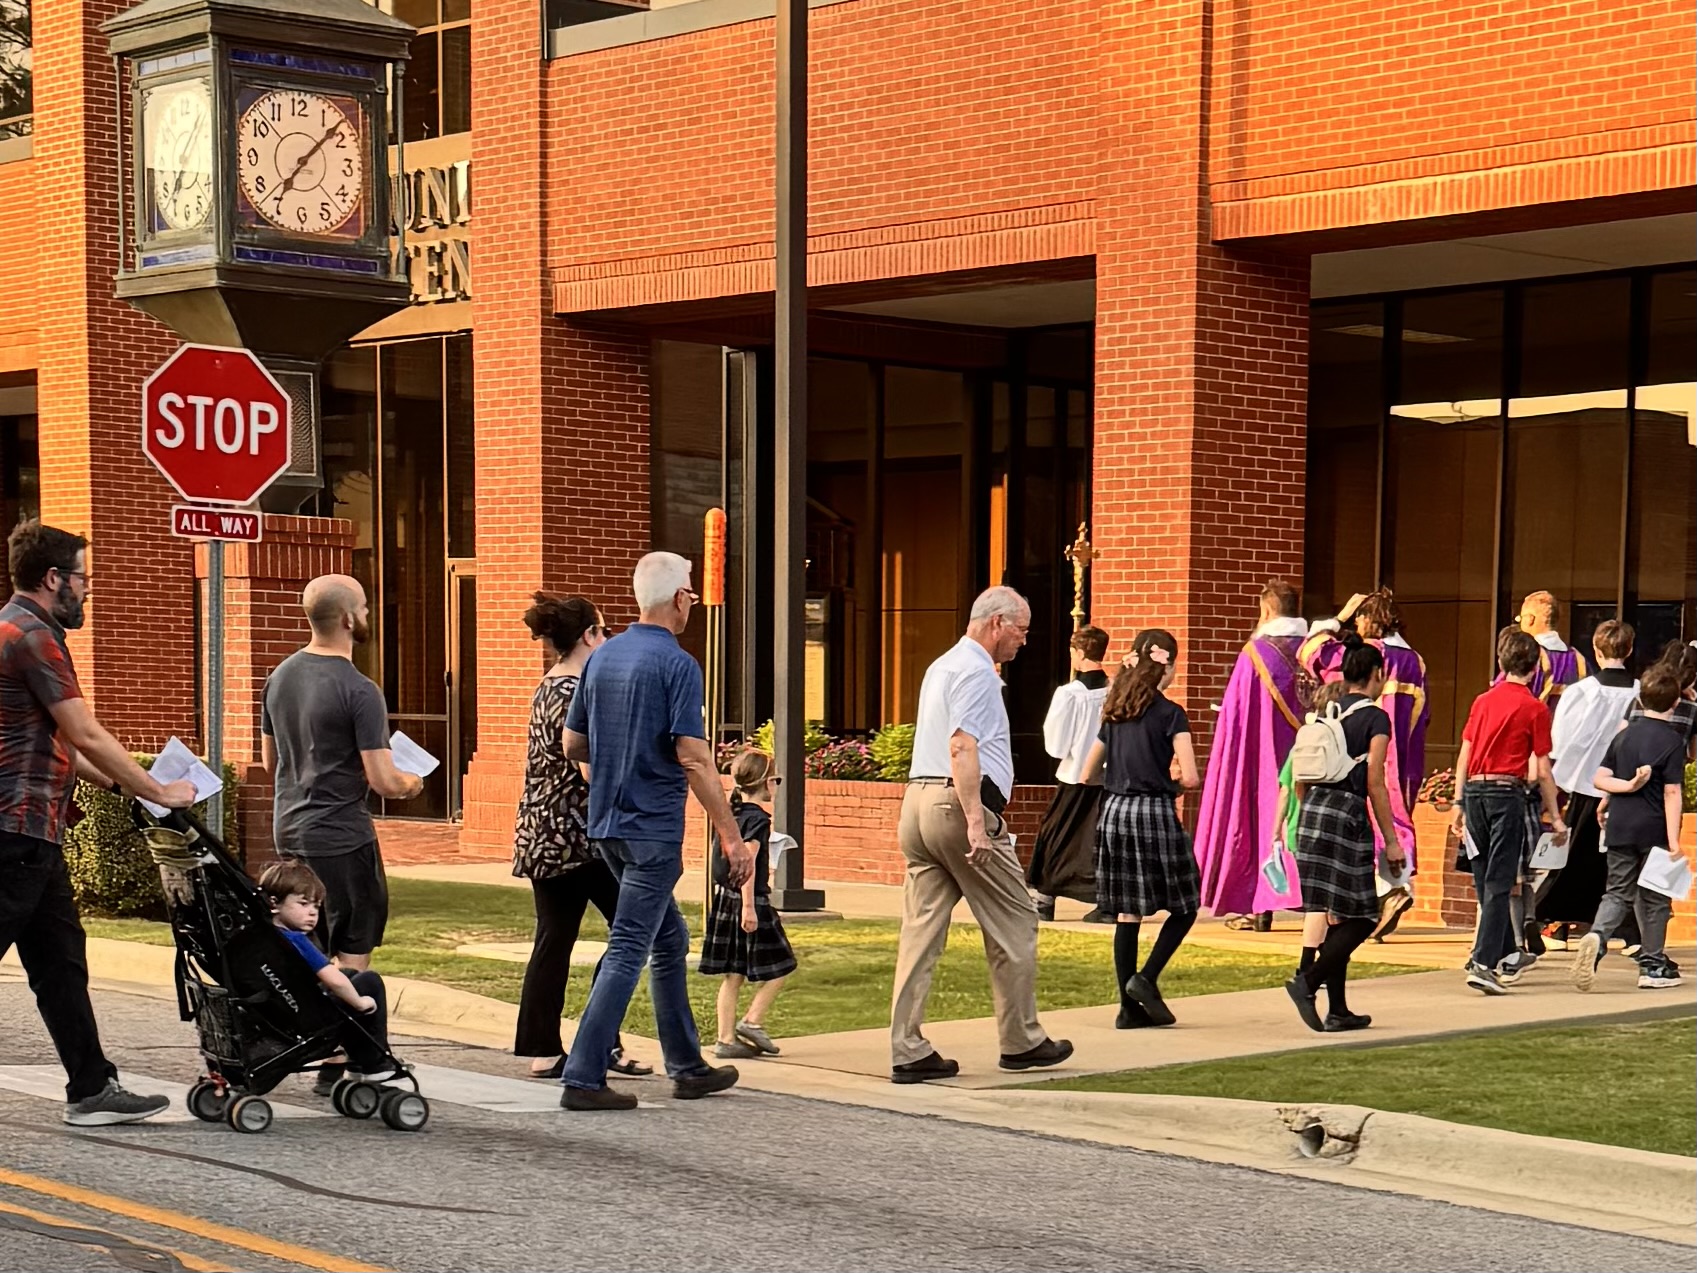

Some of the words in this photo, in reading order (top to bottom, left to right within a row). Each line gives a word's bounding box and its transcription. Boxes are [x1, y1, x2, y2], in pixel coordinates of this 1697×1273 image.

[271, 101, 281, 121] 11
[291, 97, 309, 117] 12
[321, 108, 326, 128] 1
[253, 118, 270, 138] 10
[335, 131, 347, 148] 2
[247, 147, 259, 166] 9
[342, 158, 354, 177] 3
[255, 175, 266, 193] 8
[335, 184, 349, 203] 4
[273, 196, 284, 215] 7
[319, 202, 331, 221] 5
[296, 206, 307, 225] 6
[405, 239, 473, 301] EN
[155, 392, 279, 455] STOP
[180, 513, 211, 532] ALL
[220, 516, 253, 535] WAY
